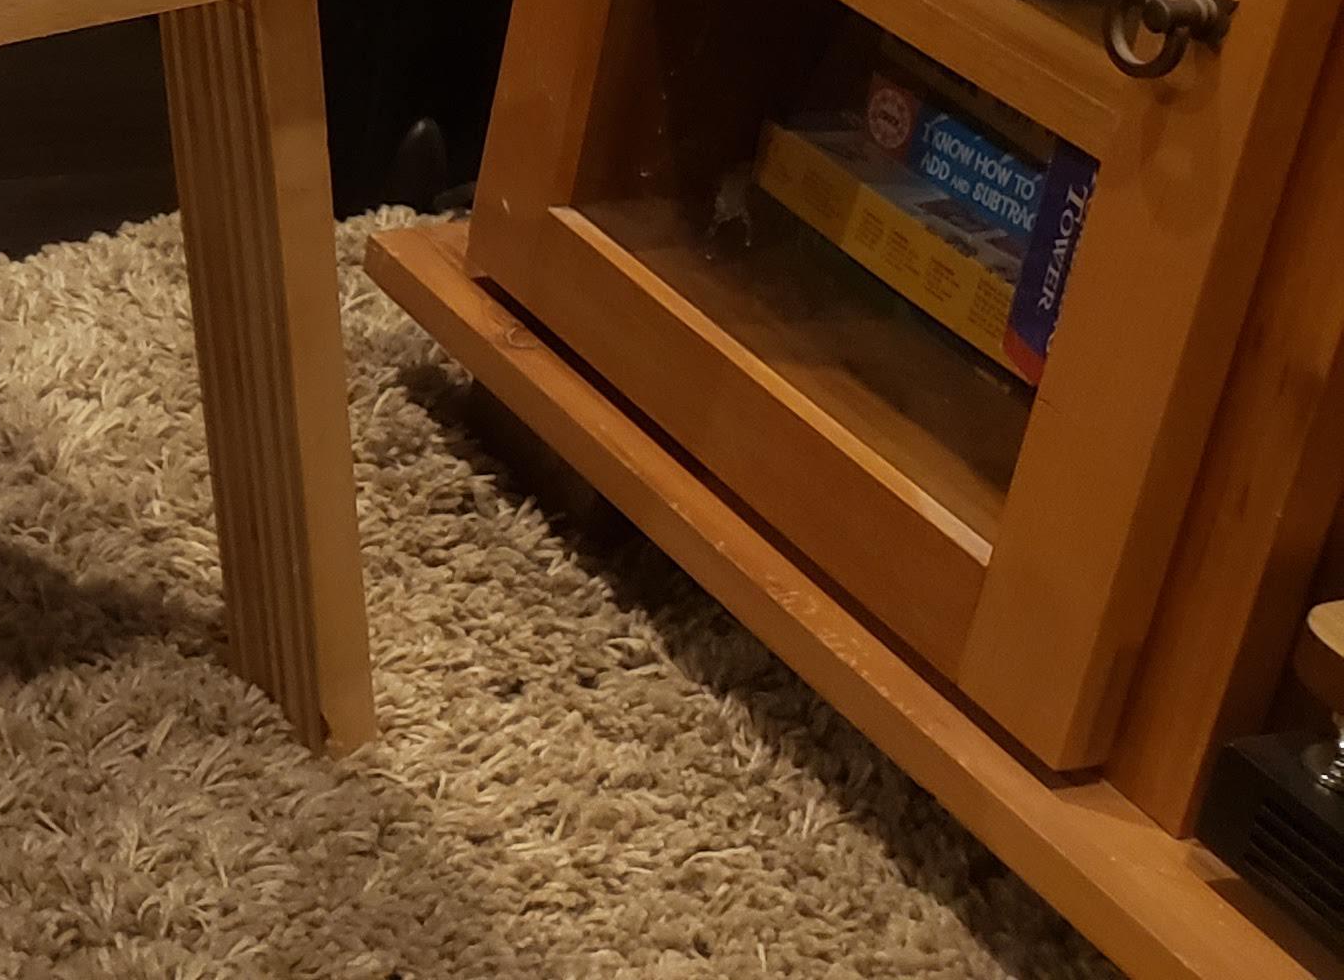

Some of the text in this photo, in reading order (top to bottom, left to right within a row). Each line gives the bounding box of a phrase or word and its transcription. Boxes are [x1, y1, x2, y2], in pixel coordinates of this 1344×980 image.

[920, 151, 950, 181] ADD
[971, 181, 1039, 233] SUBTRAC
[931, 130, 975, 167] KNOW
[973, 151, 1014, 188] HOW
[1014, 172, 1035, 201] TO
[1037, 183, 1089, 312] TOWER
